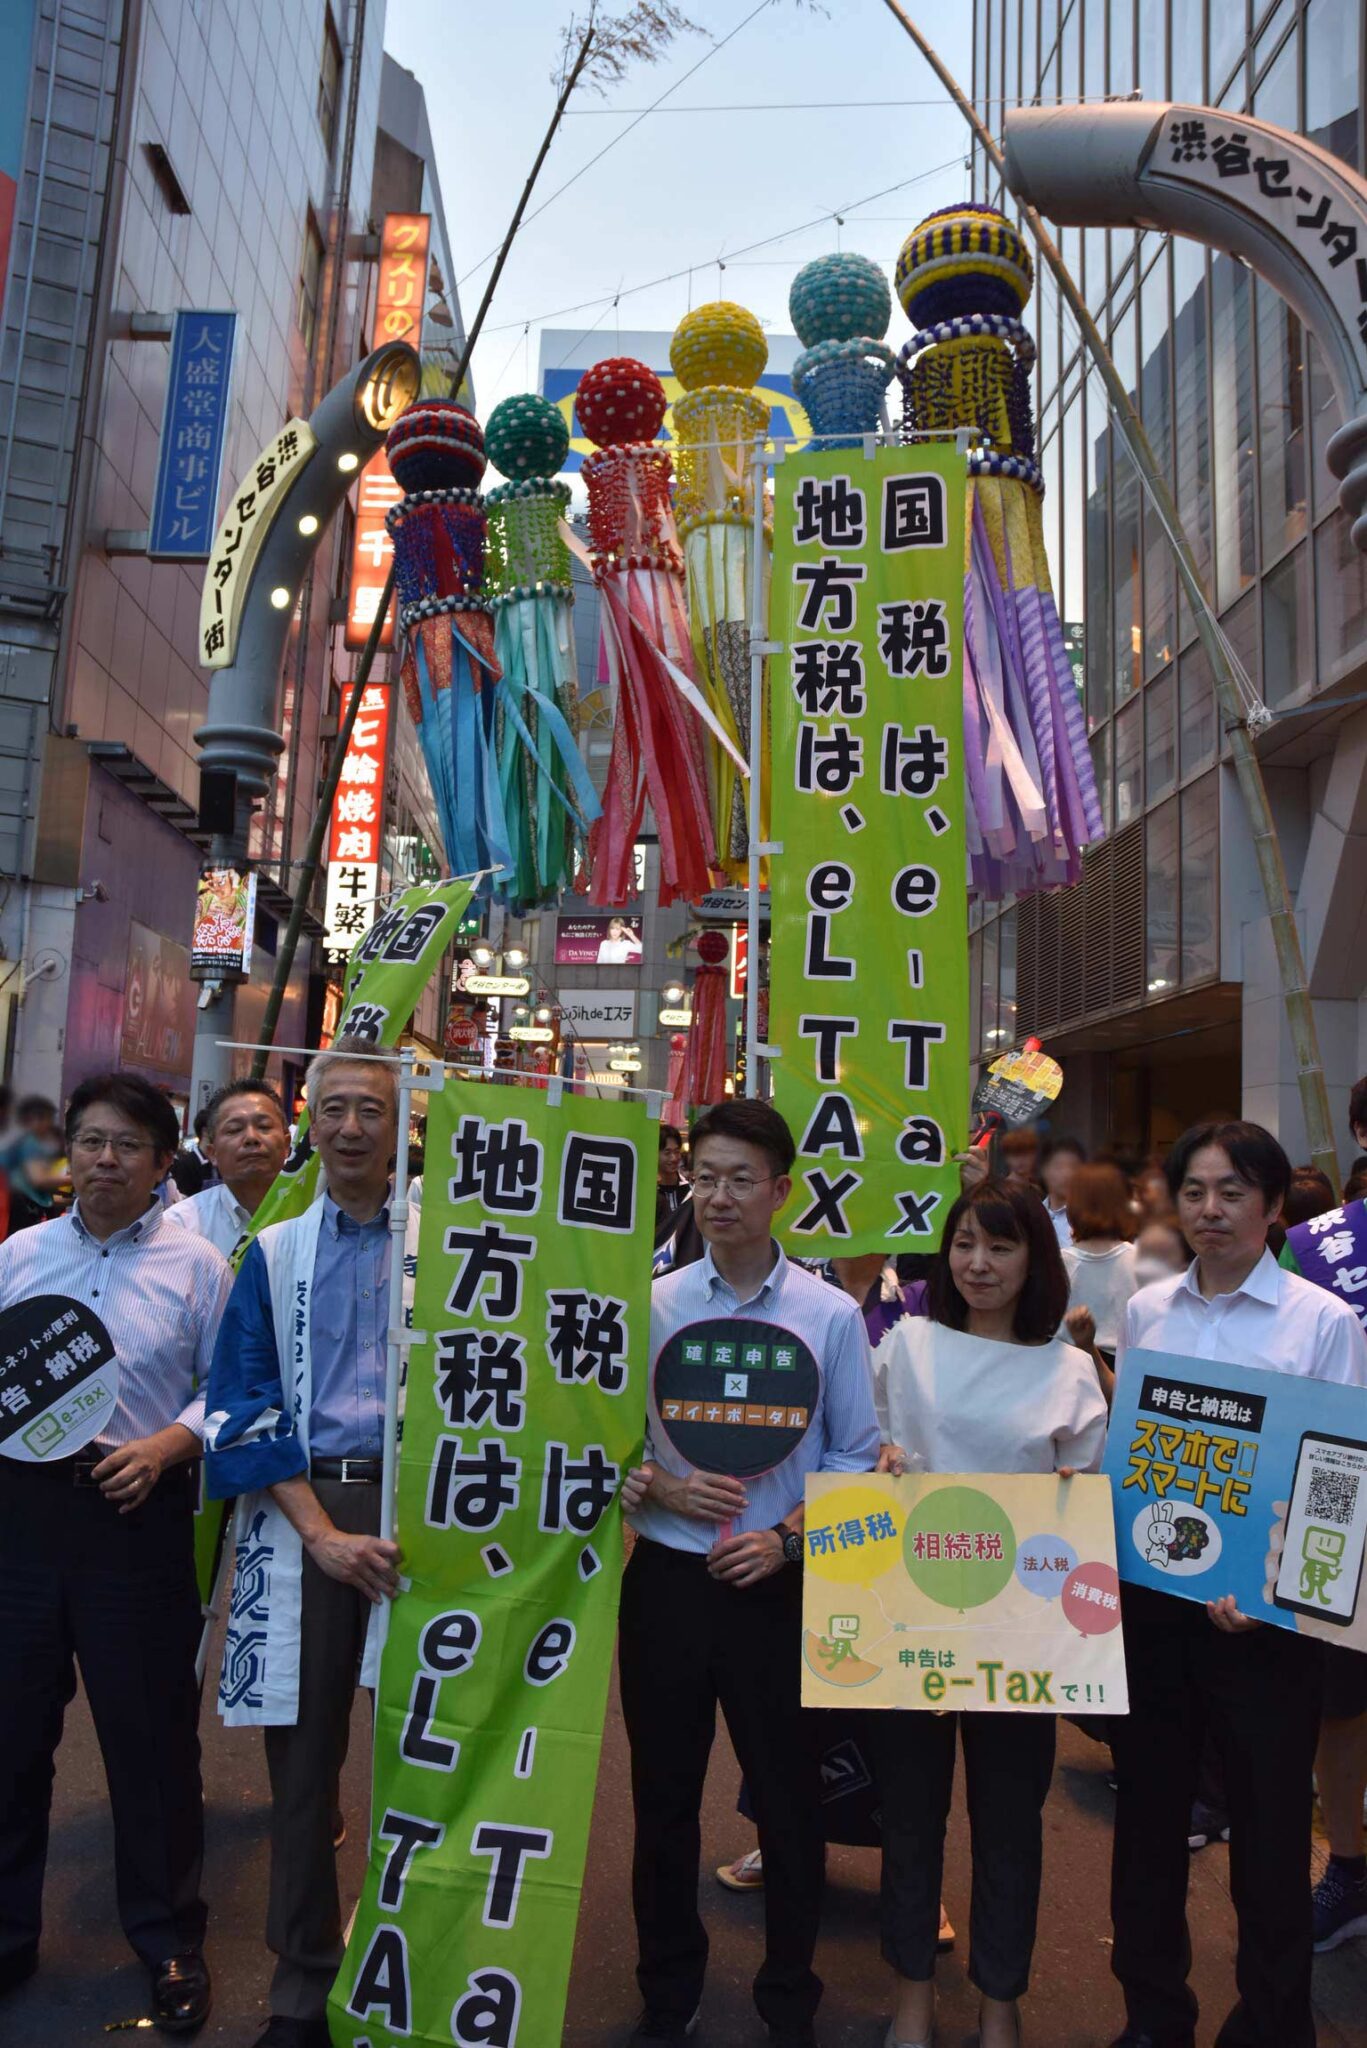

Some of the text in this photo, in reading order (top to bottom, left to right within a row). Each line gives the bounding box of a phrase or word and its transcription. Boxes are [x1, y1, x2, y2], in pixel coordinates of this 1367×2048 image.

[384, 224, 420, 338] クスリの
[167, 324, 224, 543] 大盛堂商事ビル
[203, 430, 299, 660] 渋谷センター街
[336, 718, 379, 860] 七輪焼肉
[333, 865, 367, 937] 牛繁
[685, 1344, 793, 1367] 確定申告
[61, 1386, 106, 1424] e-Tax
[665, 1404, 804, 1426] マイナポータル
[1151, 1386, 1253, 1423] 申告と納税は
[1131, 1419, 1239, 1472] スマホで
[1122, 1455, 1251, 1516] スマートに
[806, 1510, 898, 1556] 所得税
[912, 1532, 1004, 1561] 相続税
[346, 1115, 544, 2048] 地方税は、eLTA
[1022, 1555, 1070, 1573] 法人税
[1070, 1580, 1118, 1611] 消費税
[898, 1648, 956, 1669] 申告は
